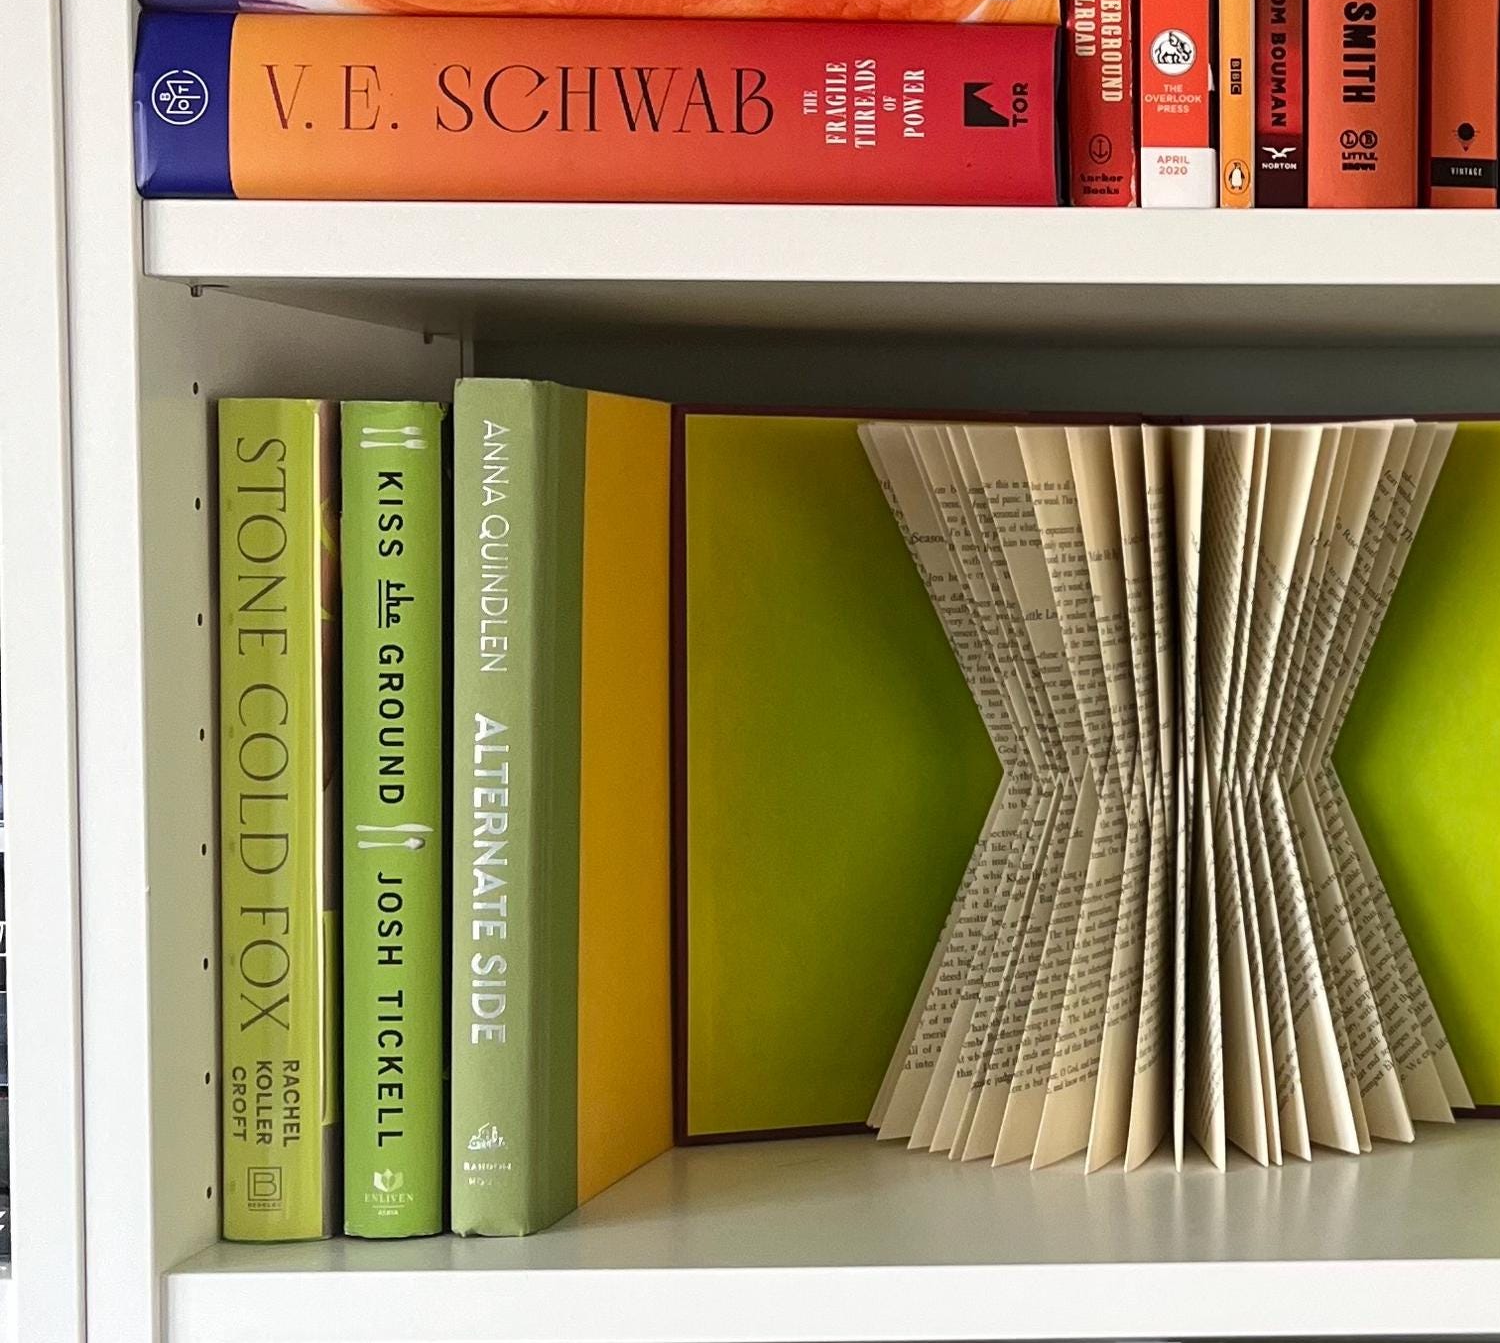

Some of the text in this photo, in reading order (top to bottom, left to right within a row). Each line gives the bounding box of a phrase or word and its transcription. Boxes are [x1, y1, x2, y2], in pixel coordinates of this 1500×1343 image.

[1342, 1, 1377, 103] SMITH
[1163, 84, 1183, 92] THE
[1230, 58, 1242, 95] BBC
[1271, 32, 1287, 127] BOUMAN
[435, 64, 774, 135] SCHWAB
[803, 89, 818, 114] THE
[826, 62, 847, 145] FRAGILE
[855, 59, 876, 148] THREADS
[883, 95, 897, 111] OF
[1012, 82, 1028, 127] TOR
[1144, 94, 1202, 103] OVERLOOK
[1157, 104, 1190, 113] PRESS
[1157, 155, 1190, 165] APRIL
[1158, 166, 1189, 175] 2020
[1261, 162, 1297, 170] NORTON
[1450, 167, 1483, 177] VINTAGE
[235, 437, 291, 1033] STONE COLD FOX
[470, 514, 510, 1045] QUINDLEN ALTERNATE SIDE
[376, 471, 405, 1148] KISS GROUND JOSH TICKELL
[231, 1065, 247, 1141] CROFT
[282, 1059, 301, 1148] RACHEL
[364, 1192, 414, 1204] ENLIVEN
